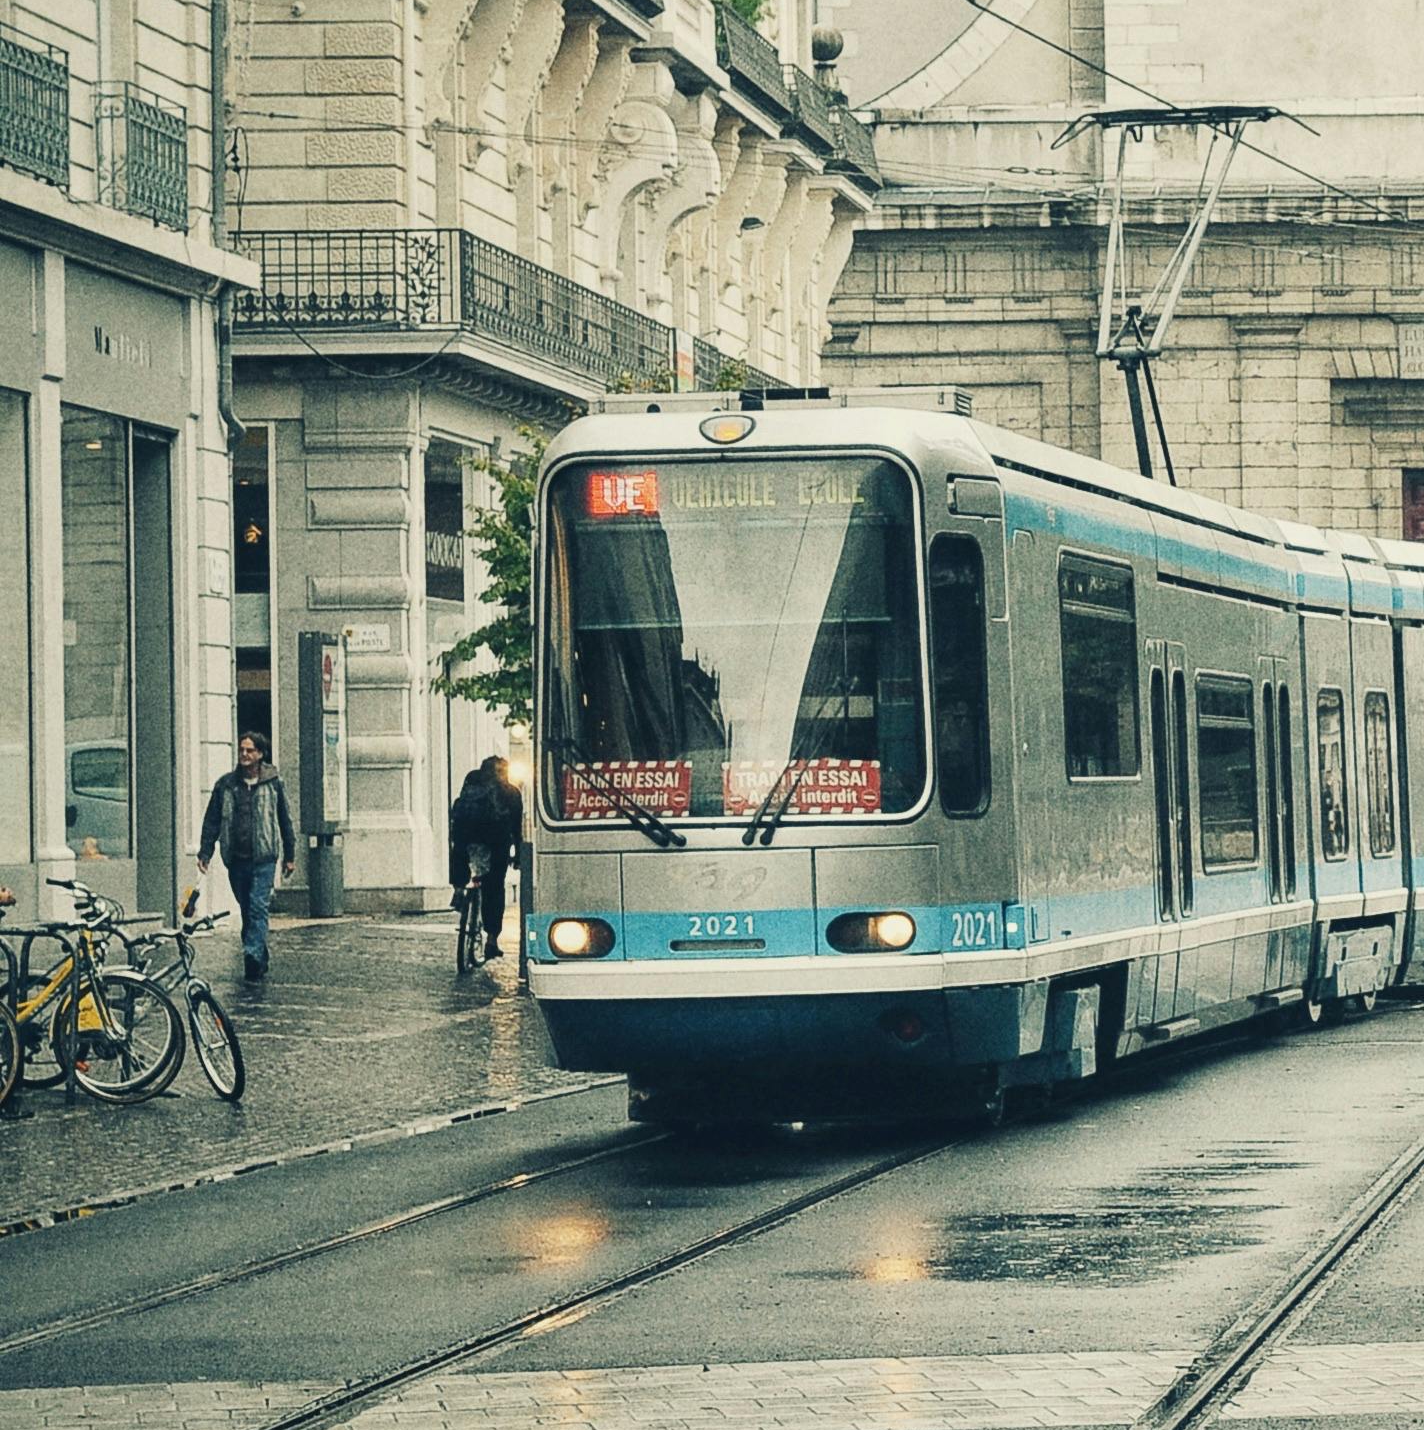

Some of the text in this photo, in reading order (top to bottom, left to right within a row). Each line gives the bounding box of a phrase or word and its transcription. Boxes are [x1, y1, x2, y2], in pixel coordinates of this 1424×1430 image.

[672, 474, 776, 509] VEHICULE
[613, 771, 633, 789] EN
[634, 770, 680, 789] ESSAI
[736, 769, 868, 788] TRAM EN ESSAI
[619, 790, 669, 808] interdit
[801, 787, 858, 805] interdit
[689, 915, 755, 937] 2021
[952, 911, 996, 947] 2021
